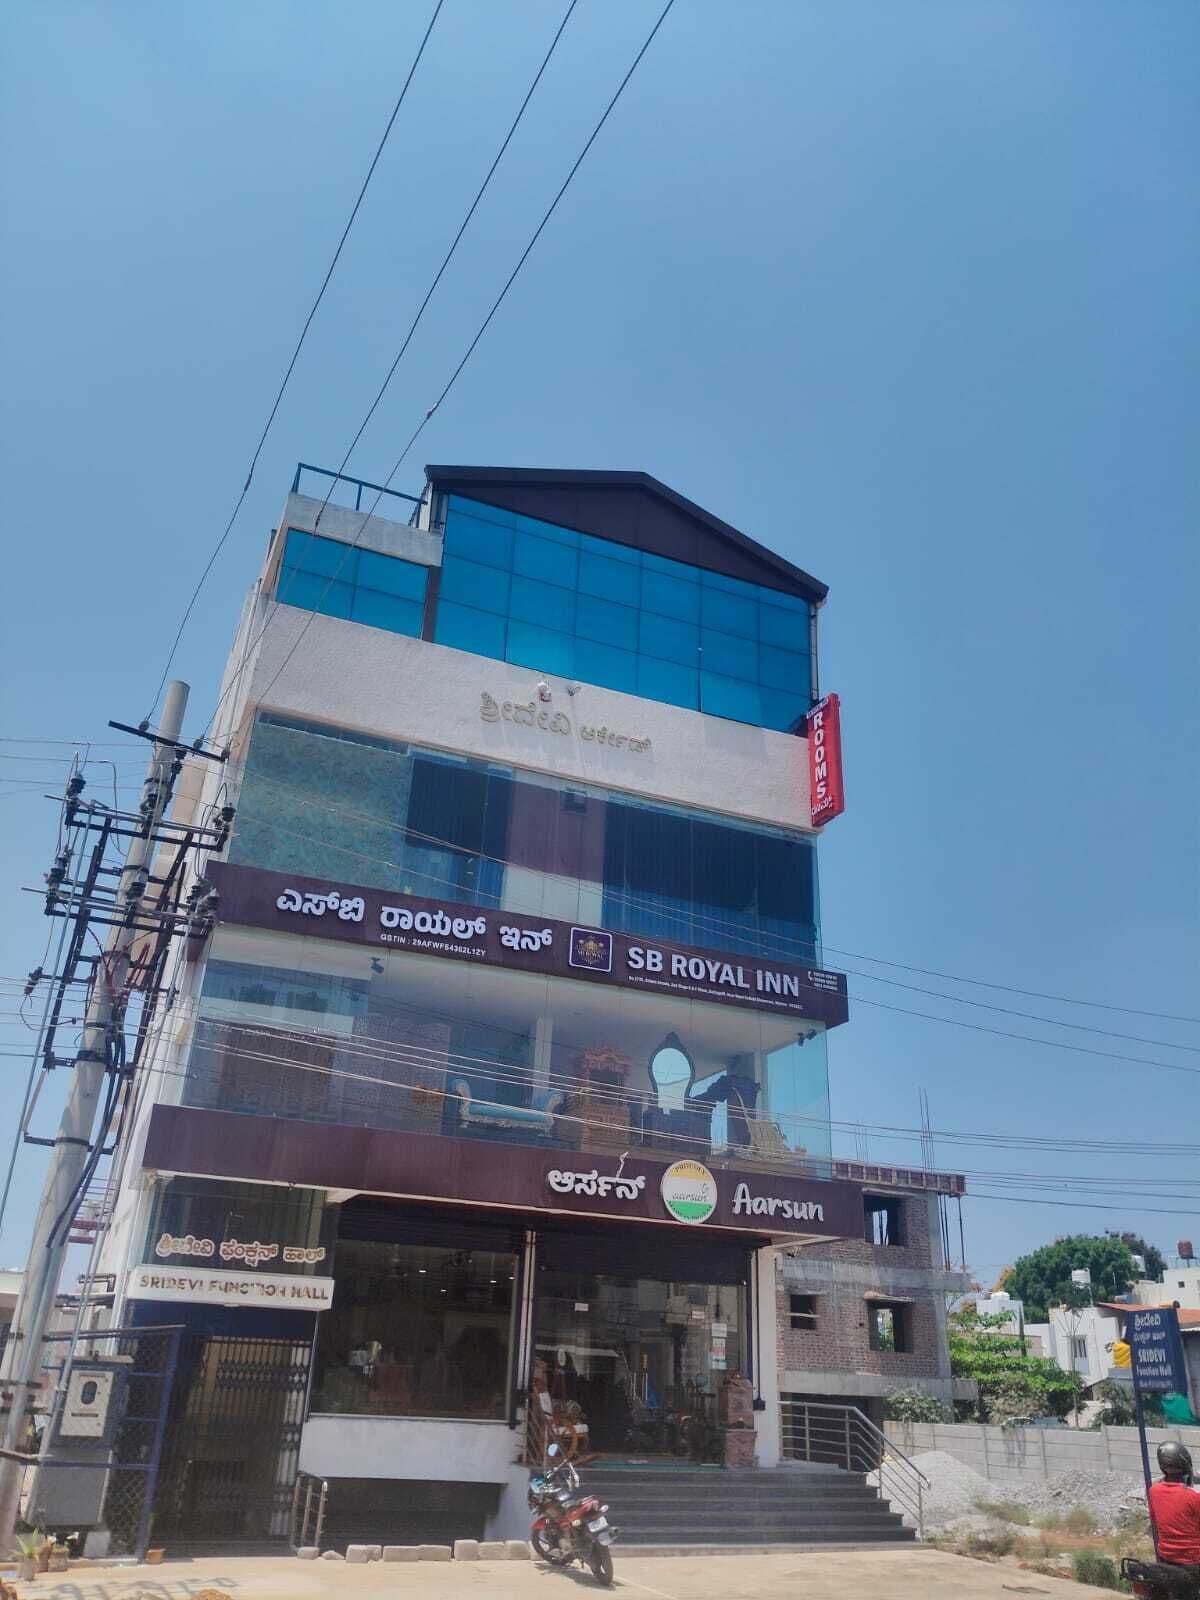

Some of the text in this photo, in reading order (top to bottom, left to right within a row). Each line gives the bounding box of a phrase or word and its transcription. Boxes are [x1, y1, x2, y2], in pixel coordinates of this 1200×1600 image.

[812, 711, 827, 799] ROOMS
[380, 905, 487, 940] ರಾಯಲ್
[499, 925, 553, 953] ಇನ್
[380, 933, 406, 944] GSTIN
[627, 946, 663, 973] SB
[671, 954, 750, 989] ROYAL
[756, 968, 800, 997] INN
[548, 1168, 645, 1200] ಆರ್ಸನ್
[732, 1182, 824, 1222] Aarsun
[283, 1246, 326, 1263] ಹಾಲ್
[140, 1274, 329, 1301] SRIDEVI FUNCTION HALL
[1138, 1348, 1166, 1363] SRIDEVI
